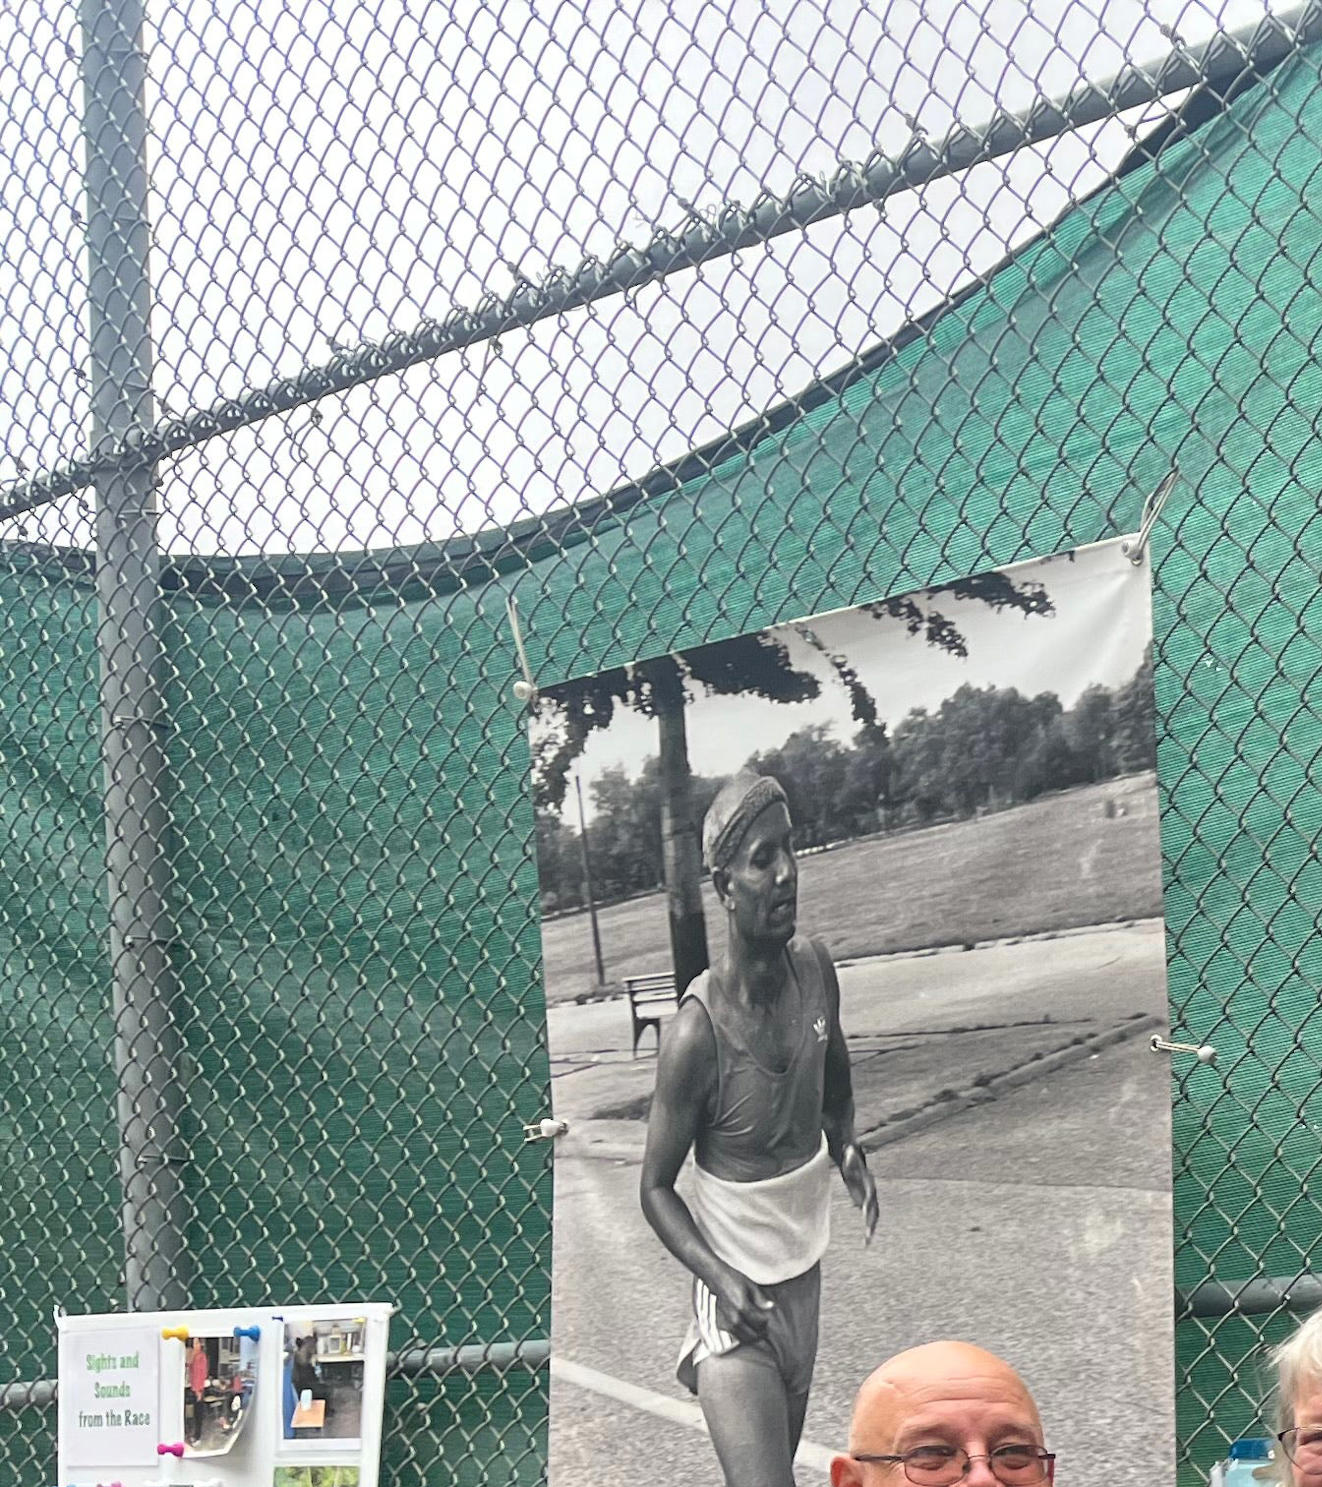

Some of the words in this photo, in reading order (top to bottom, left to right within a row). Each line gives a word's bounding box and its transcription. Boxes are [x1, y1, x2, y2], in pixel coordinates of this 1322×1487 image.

[120, 1350, 139, 1368] and
[94, 1381, 130, 1399] Sounds
[79, 1411, 103, 1428] from
[106, 1409, 122, 1426] the
[125, 1408, 150, 1426] Race
